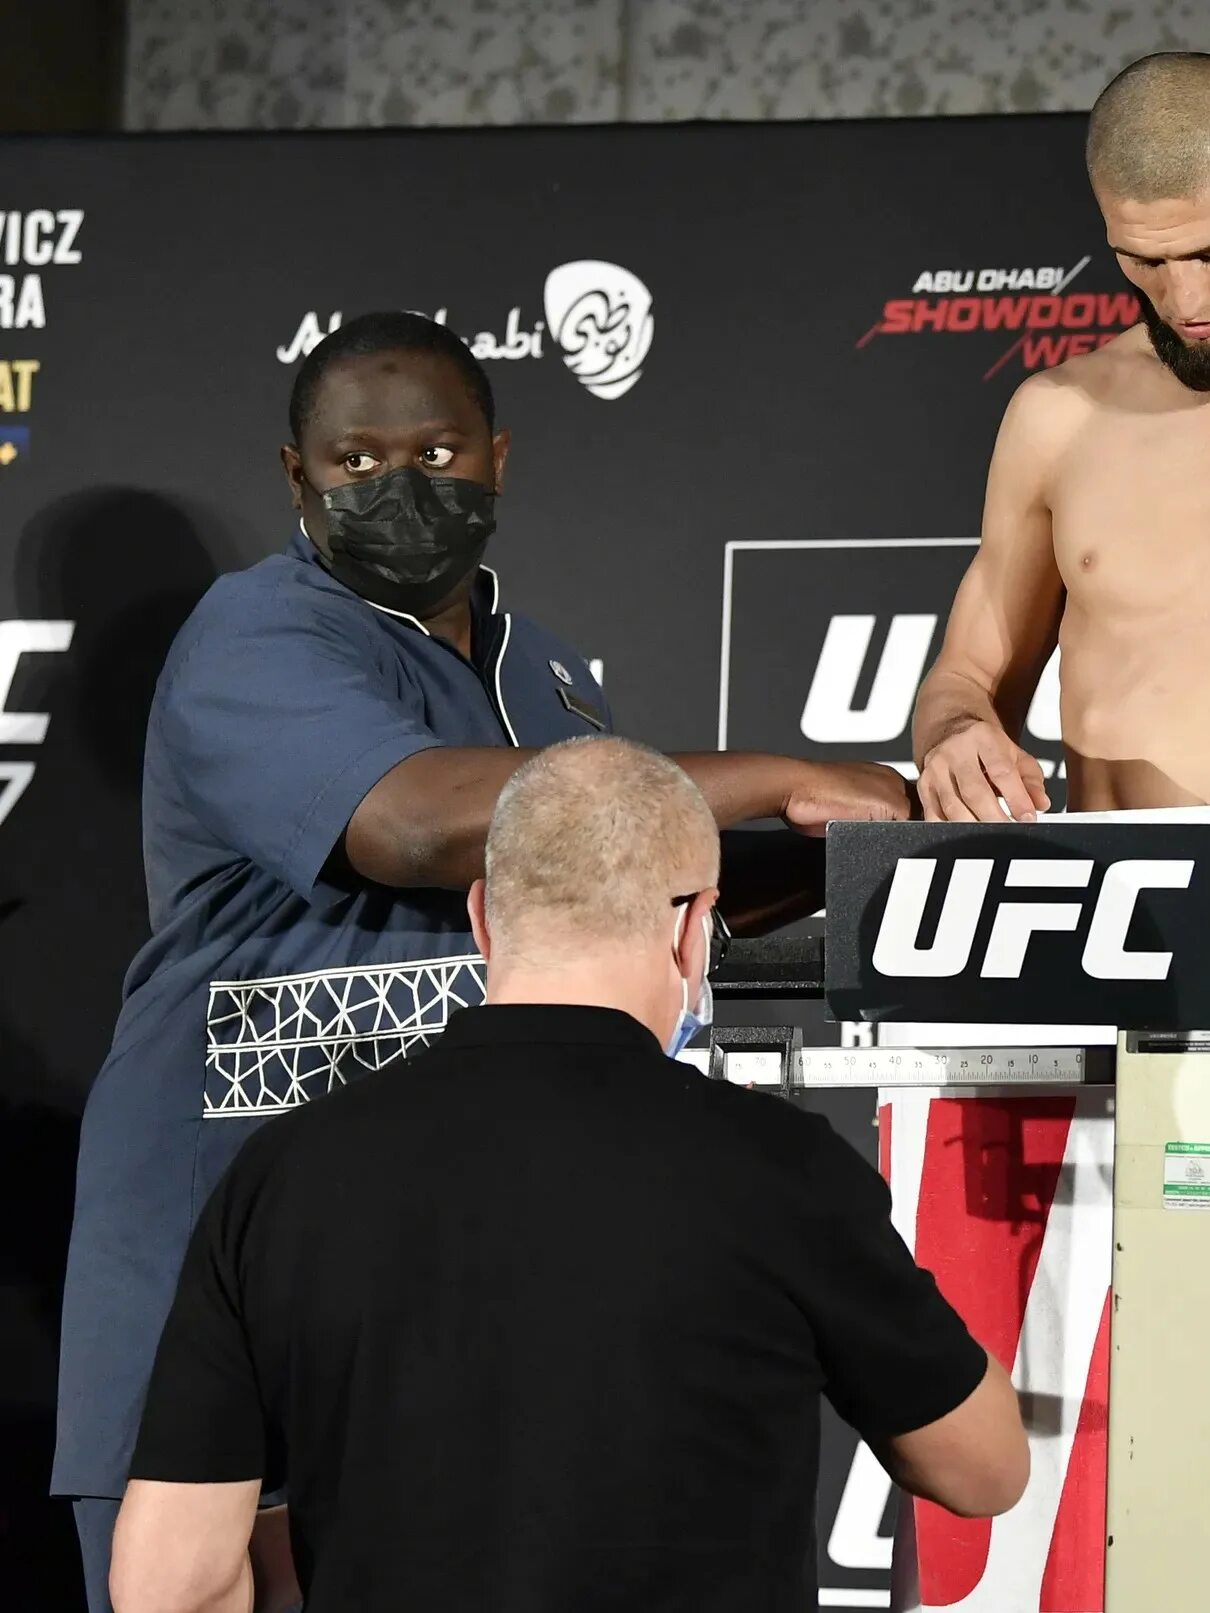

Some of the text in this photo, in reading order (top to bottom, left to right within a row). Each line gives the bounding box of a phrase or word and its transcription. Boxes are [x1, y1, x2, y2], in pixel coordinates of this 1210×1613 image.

[912, 267, 1064, 293] ABU DHABI
[879, 293, 1141, 333] SHOWDOW
[872, 857, 1195, 980] UFC
[843, 1056, 857, 1066] 50
[888, 1055, 902, 1065] 40
[960, 1060, 969, 1068] 25
[980, 1054, 994, 1065] 20
[1007, 1060, 1015, 1068] 15
[1028, 1054, 1039, 1064] 10
[1075, 1054, 1082, 1064] 0
